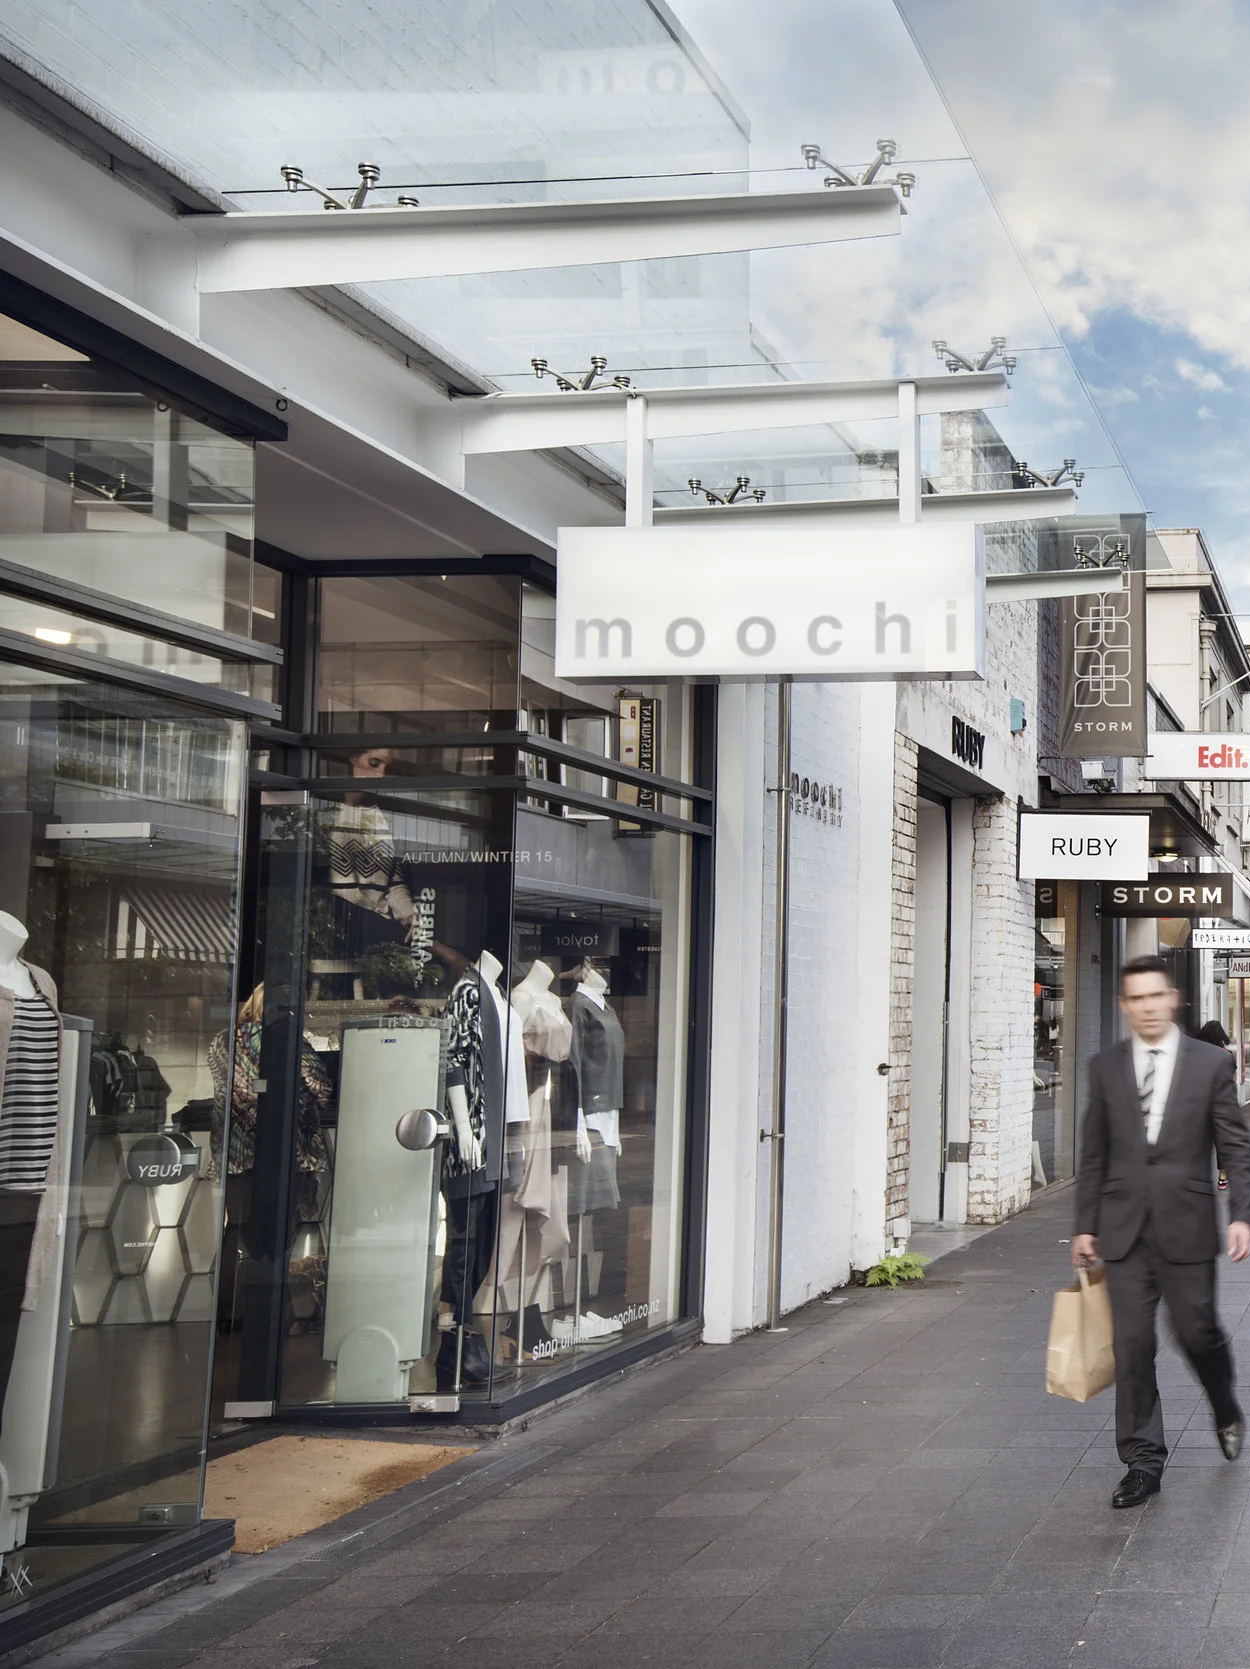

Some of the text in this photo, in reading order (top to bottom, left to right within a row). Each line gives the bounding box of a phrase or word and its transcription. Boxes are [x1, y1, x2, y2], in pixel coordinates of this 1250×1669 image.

[574, 600, 958, 659] moochi
[1073, 721, 1133, 733] STORM
[951, 715, 985, 770] RUBY
[1197, 743, 1249, 769] Edit.
[401, 850, 553, 864] AUTUMN/WINTER 15
[1051, 837, 1118, 856] RUBY
[1112, 886, 1223, 904] STORM
[532, 1337, 558, 1361] shop
